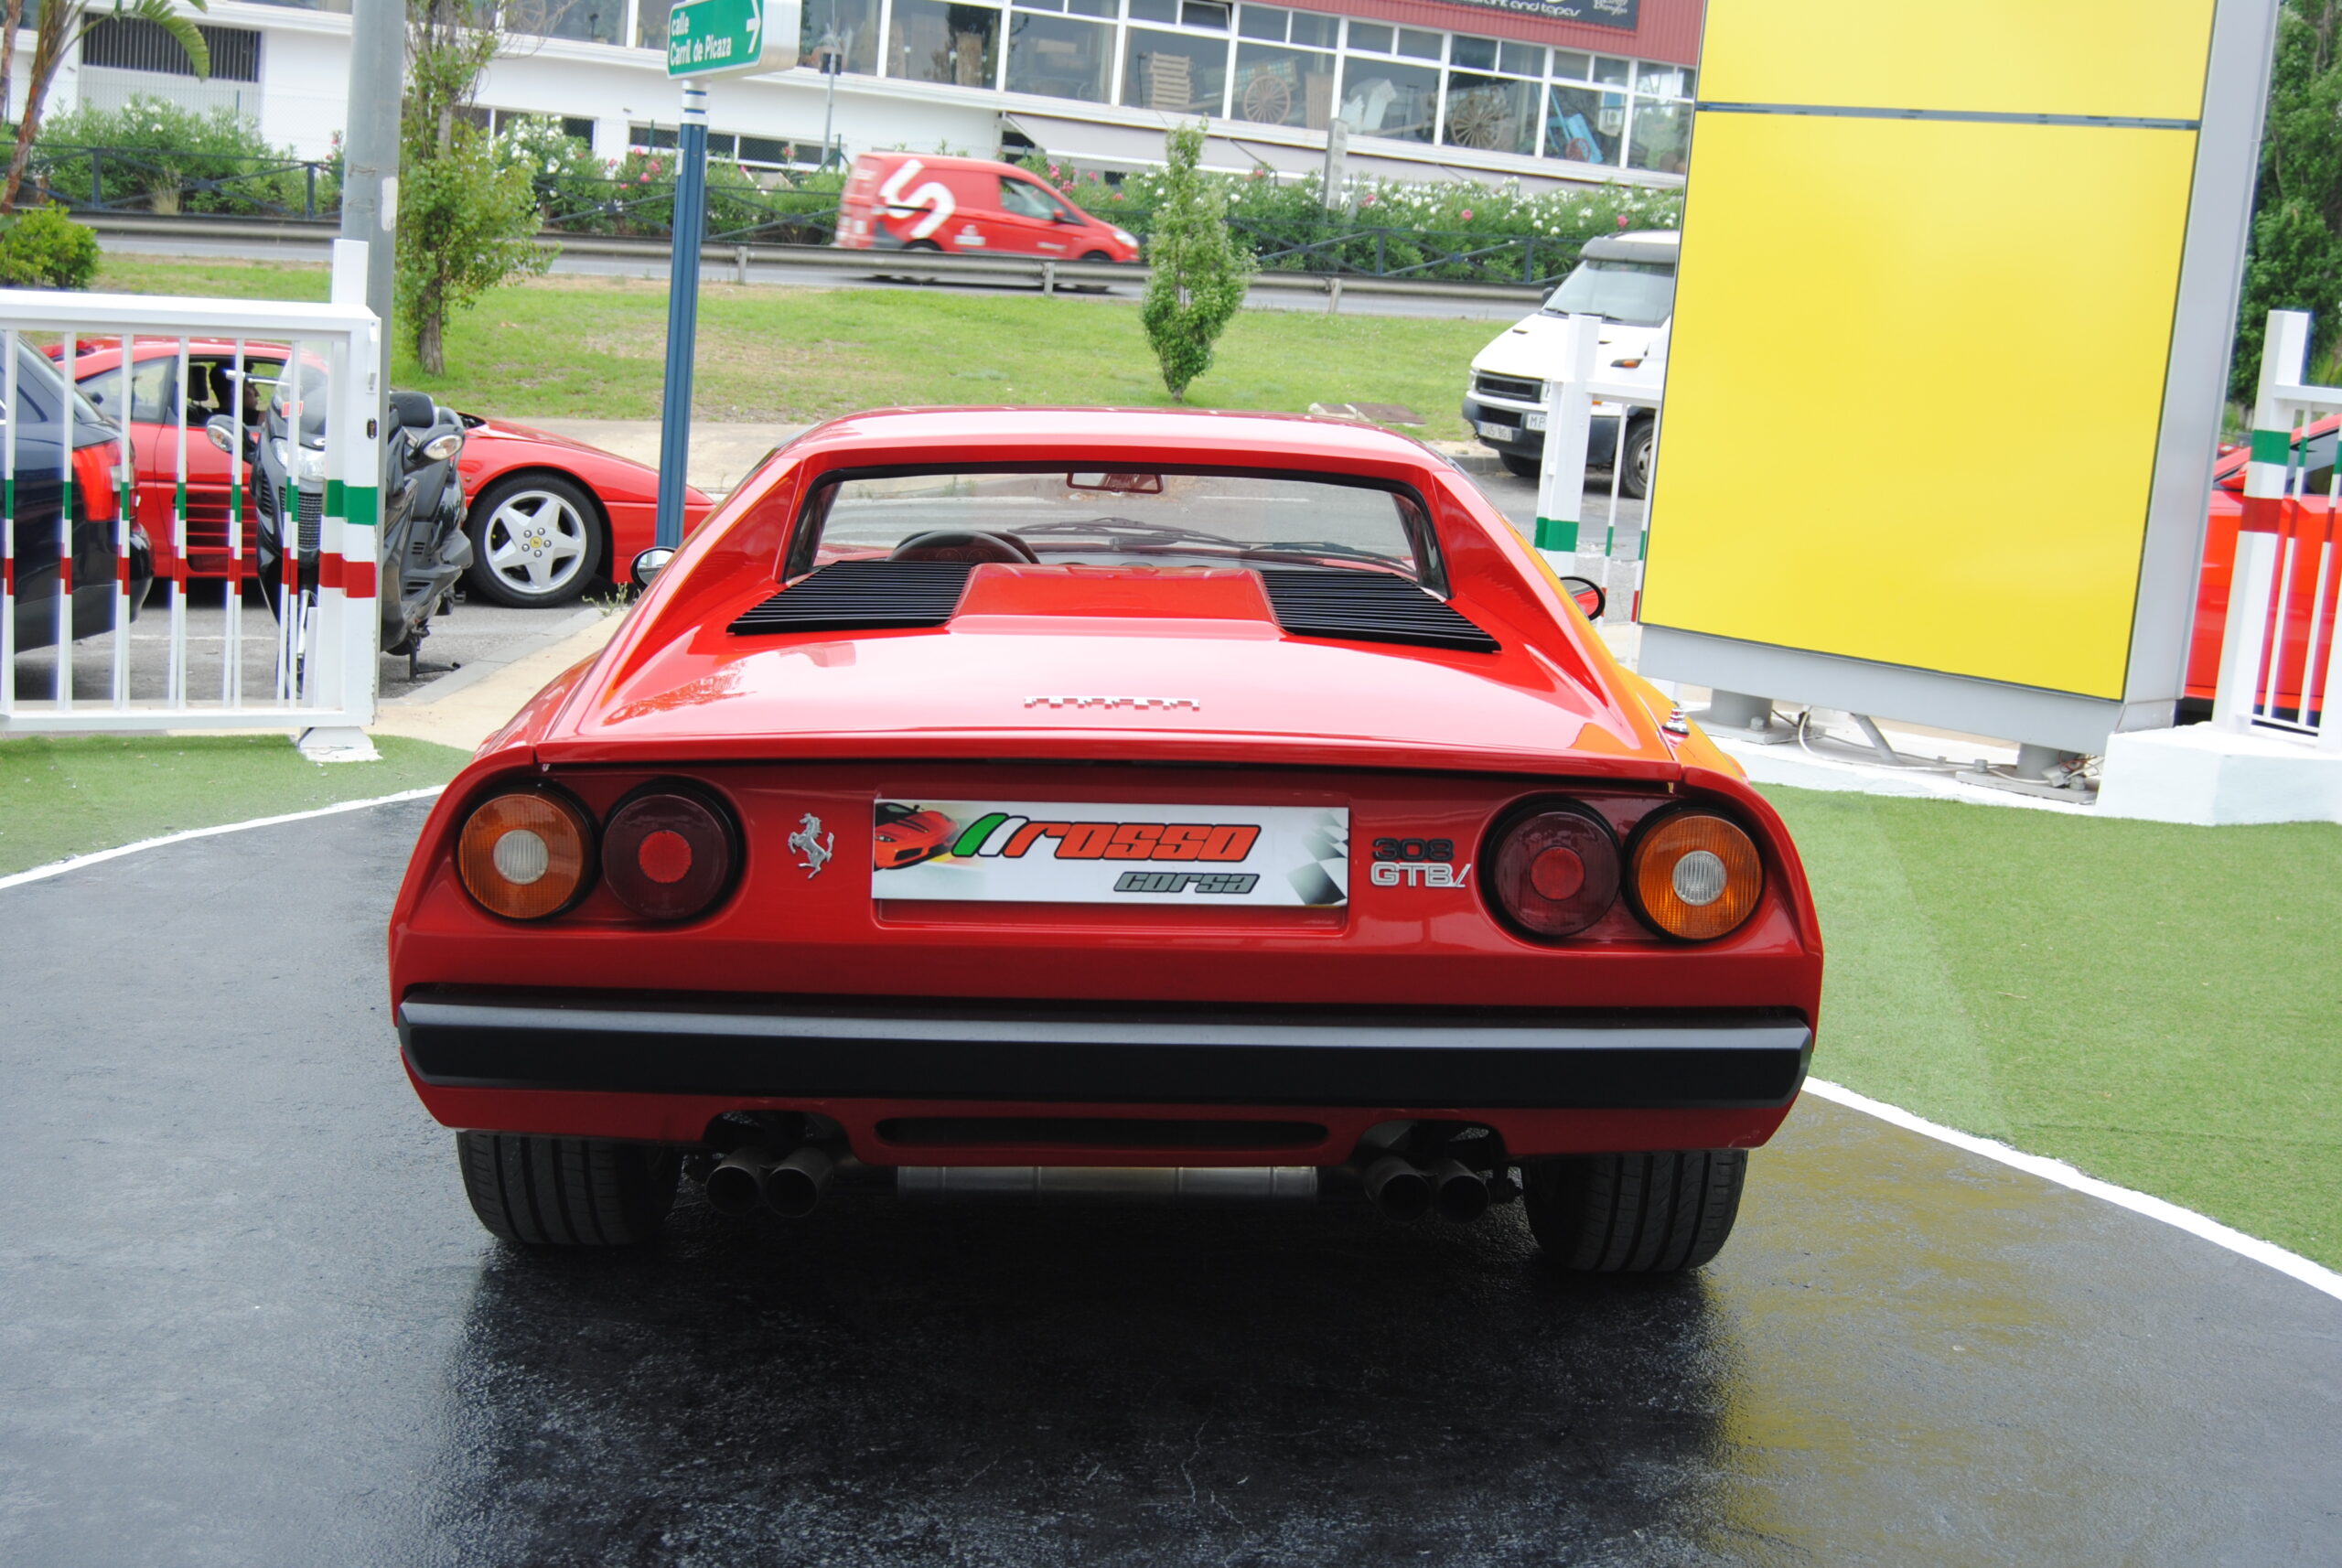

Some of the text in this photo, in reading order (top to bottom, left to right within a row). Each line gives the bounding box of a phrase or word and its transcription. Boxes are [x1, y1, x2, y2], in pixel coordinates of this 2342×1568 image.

[670, 34, 732, 67] Carril de Picaza
[1003, 821, 1262, 863] rosso
[1372, 837, 1454, 862] 308
[1112, 871, 1261, 895] corsa
